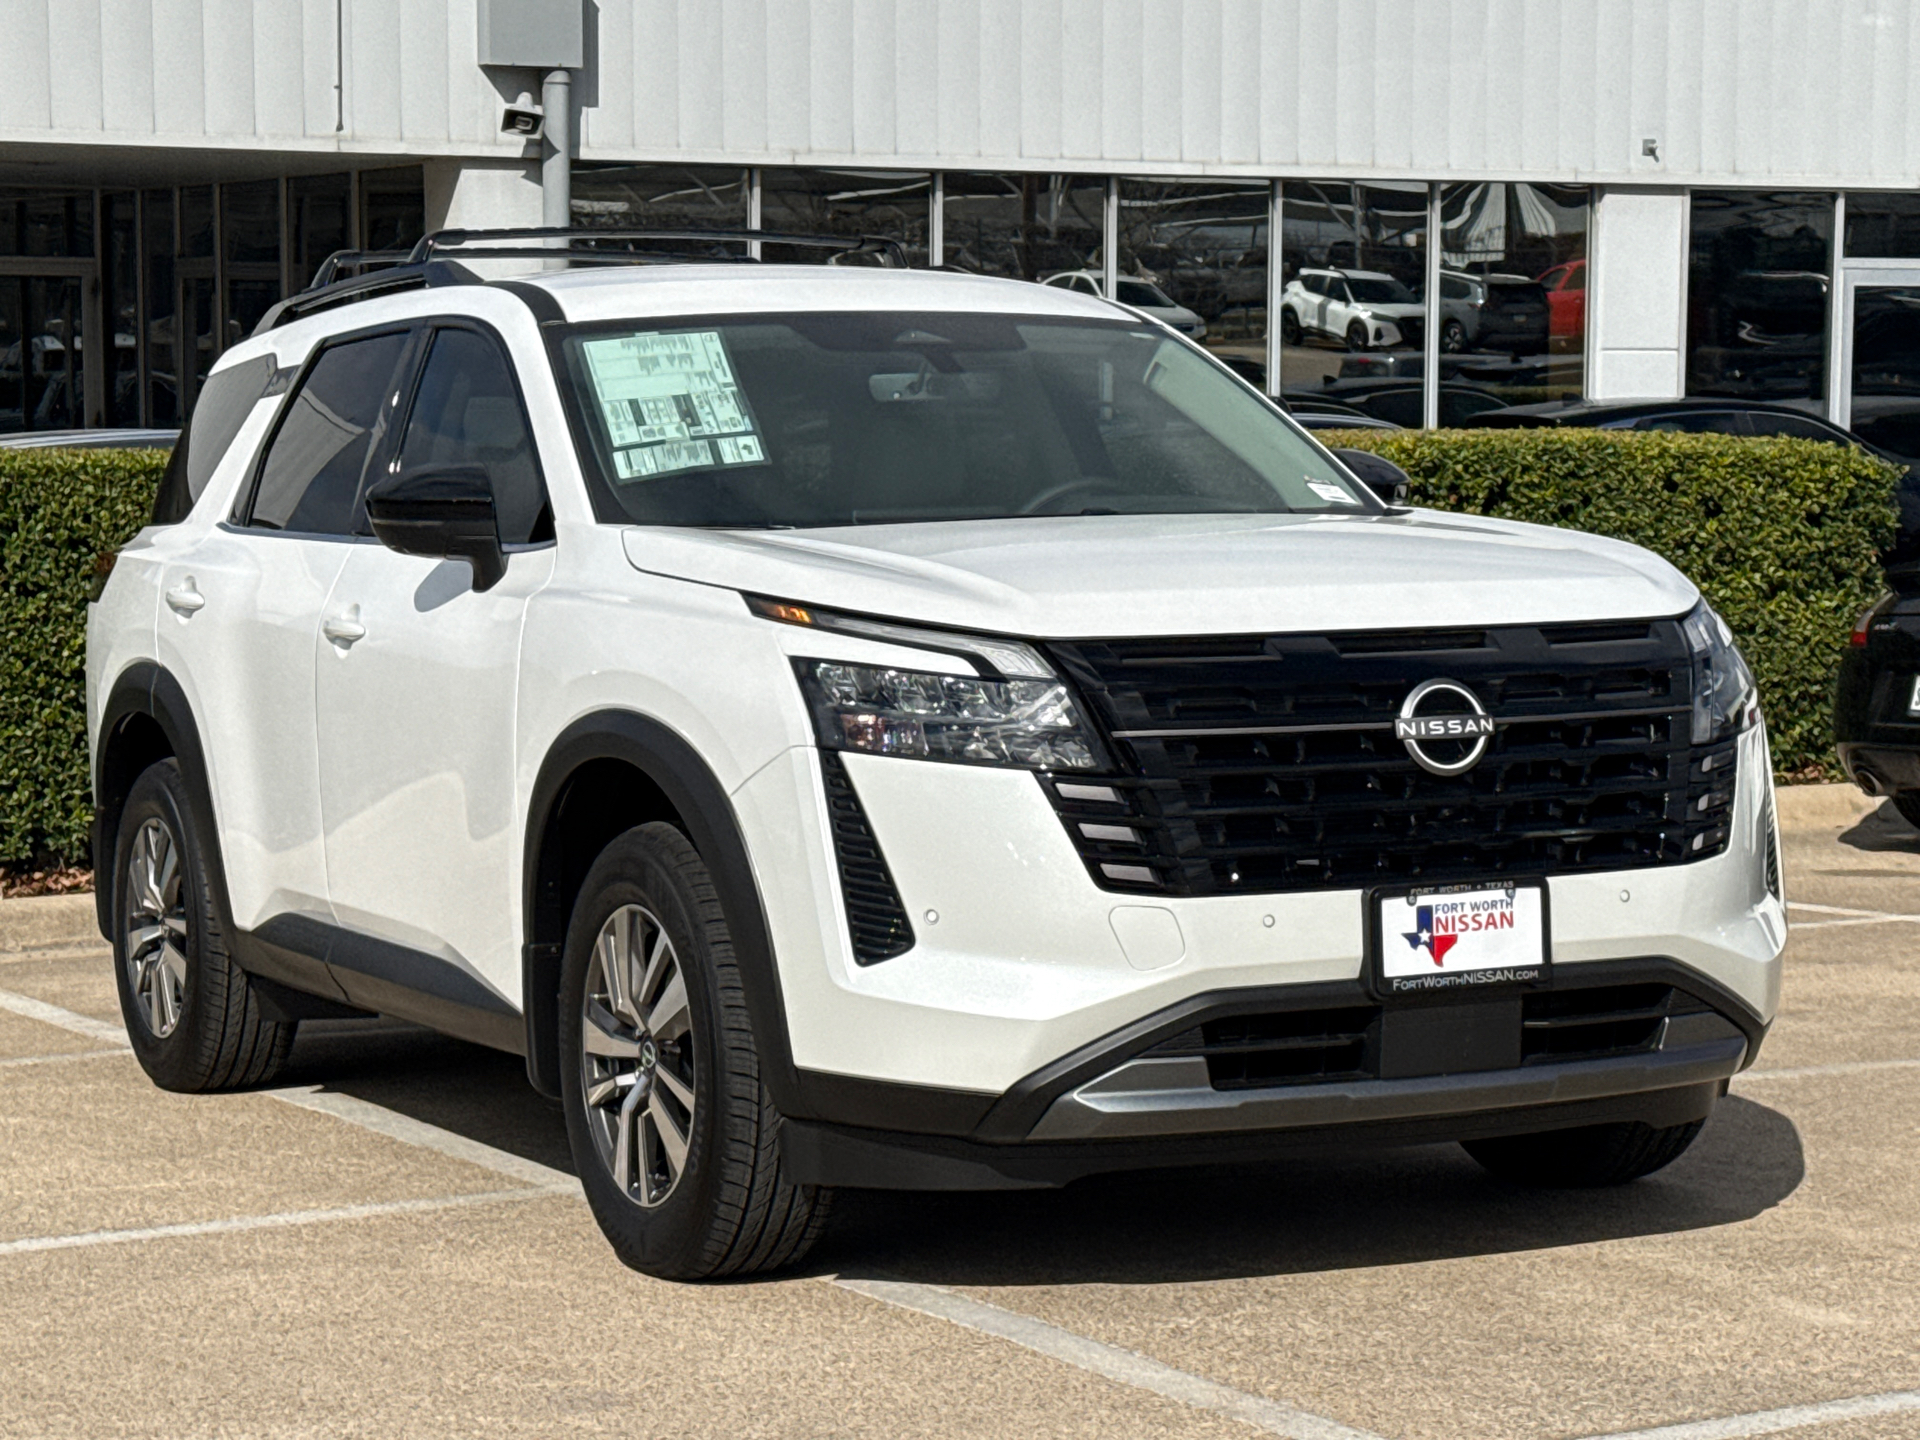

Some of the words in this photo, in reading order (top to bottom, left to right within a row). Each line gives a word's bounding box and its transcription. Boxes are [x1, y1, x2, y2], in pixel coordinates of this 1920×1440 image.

[1399, 718, 1493, 736] NISSAN
[1411, 886, 1435, 896] FORT
[1439, 884, 1472, 894] WORTH
[1485, 880, 1514, 889] TEXAS
[1434, 902, 1466, 915] FORT
[1469, 898, 1514, 912] WORTH
[1435, 911, 1514, 934] NISSAN
